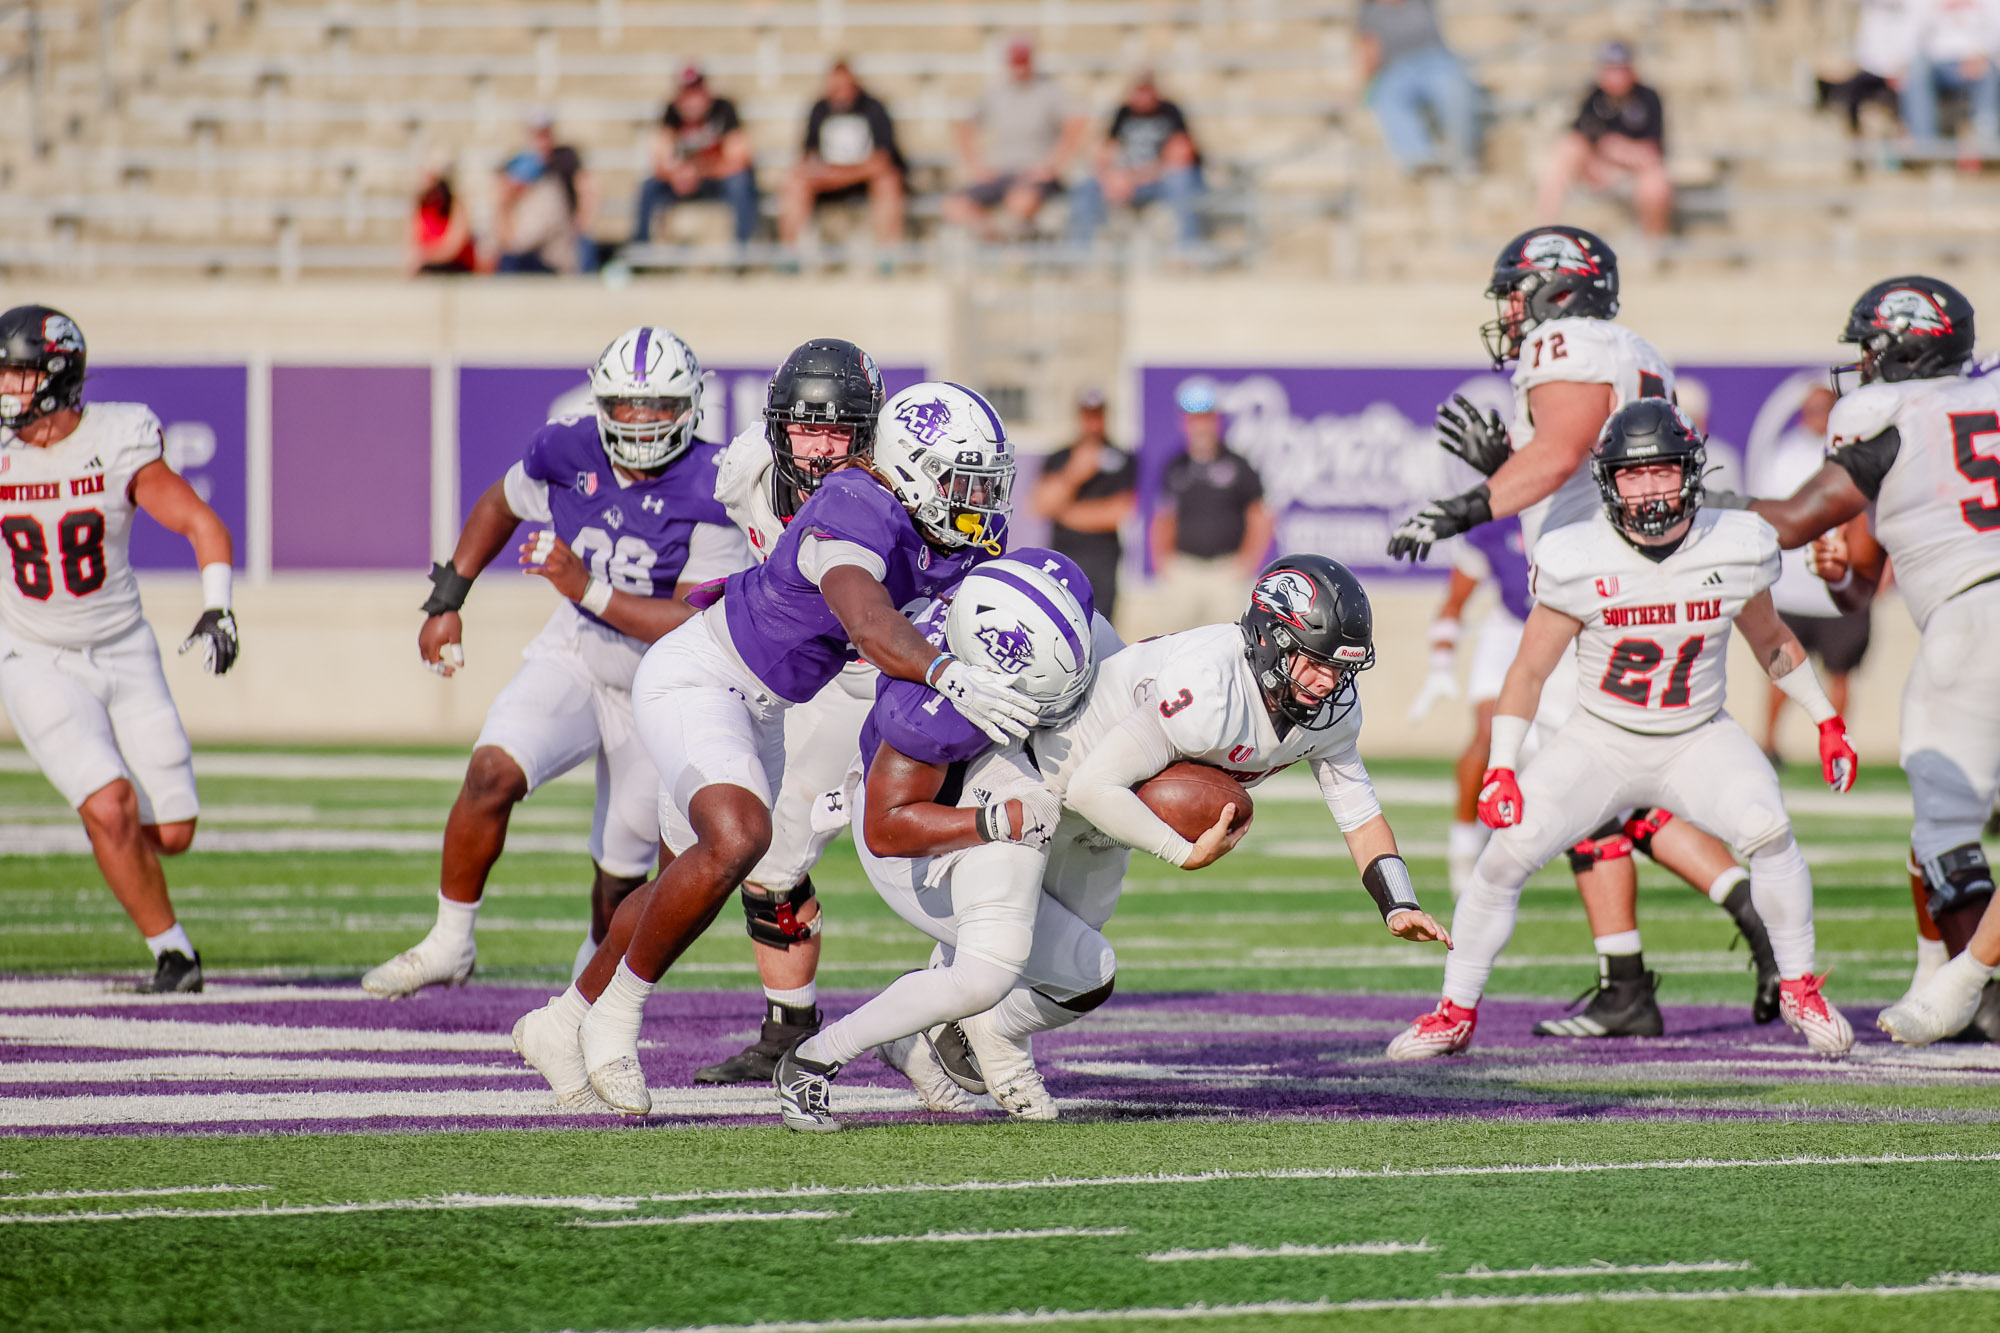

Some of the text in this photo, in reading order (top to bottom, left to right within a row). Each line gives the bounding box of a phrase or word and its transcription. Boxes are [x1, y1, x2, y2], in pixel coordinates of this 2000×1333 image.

[0, 474, 105, 501] OUTHERN UTAH
[0, 508, 107, 601] 88
[1602, 598, 1722, 627] SOUTHERN UTAH
[1601, 634, 1705, 708] 21
[1159, 688, 1194, 718] 3
